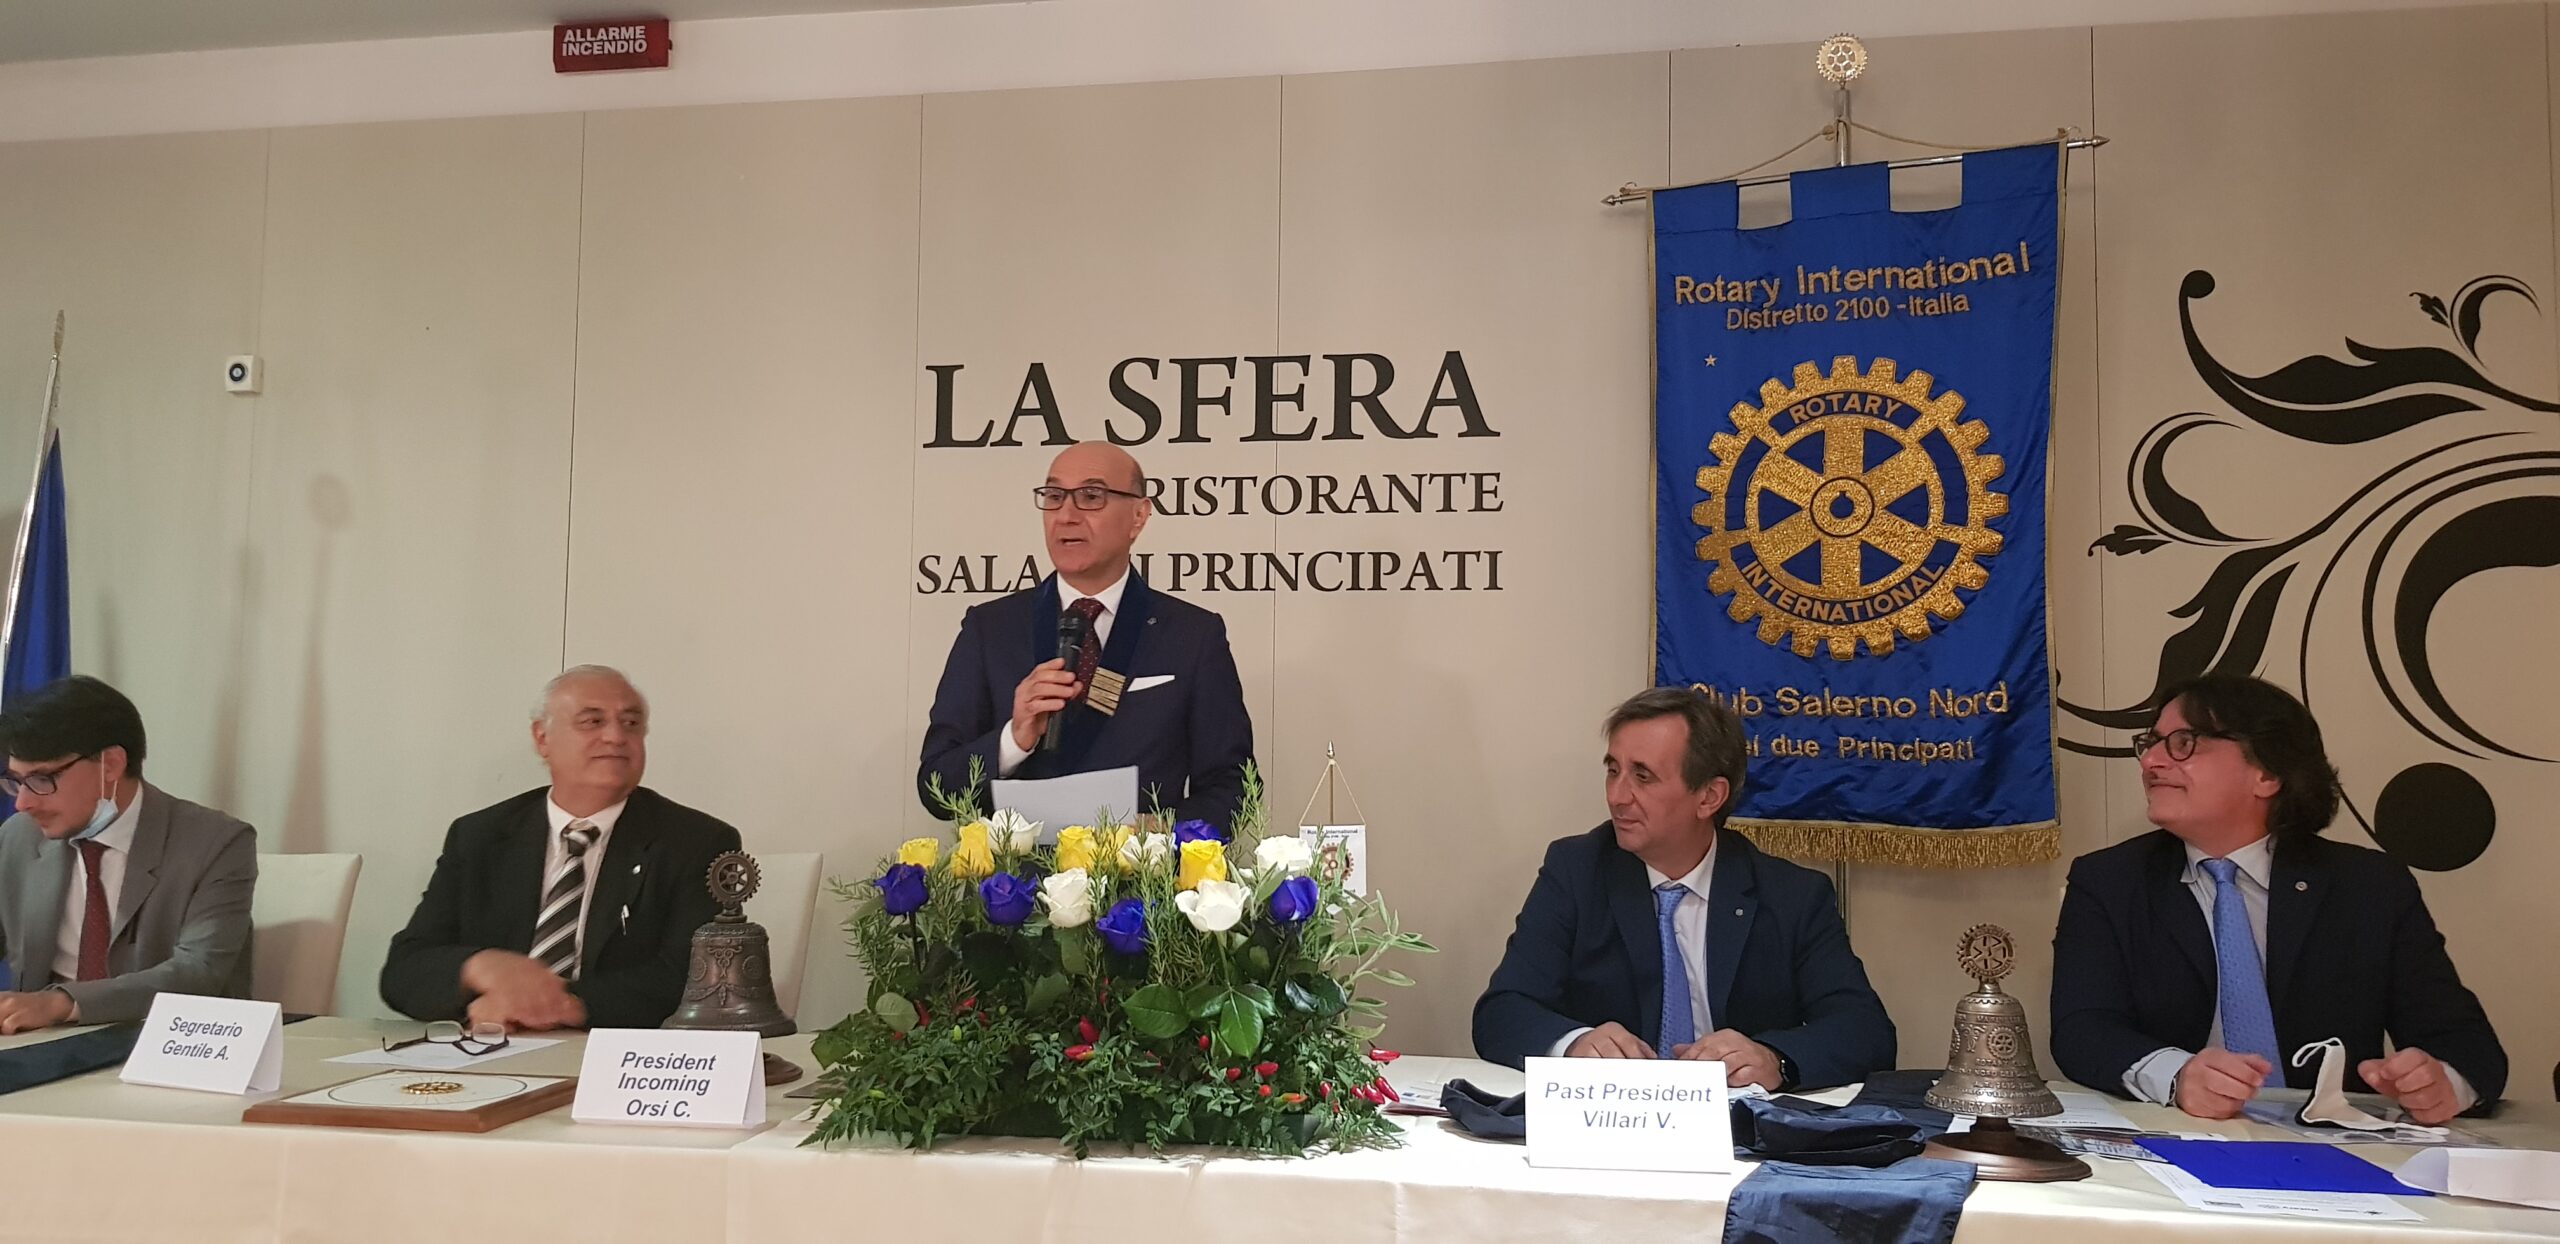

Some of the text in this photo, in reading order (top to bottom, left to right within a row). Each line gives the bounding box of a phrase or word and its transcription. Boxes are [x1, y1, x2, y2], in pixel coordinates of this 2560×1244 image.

[562, 39, 648, 56] INCENDIO
[563, 26, 646, 42] ALLARME
[1674, 240, 2031, 308] Rotary International
[1726, 301, 1829, 330] Distretto
[1834, 297, 1890, 321] 2100
[923, 350, 1501, 449] LA SFERA
[1789, 393, 1902, 424] ROTARY
[1145, 472, 1504, 517] RISTORANTE
[917, 554, 1042, 594] SALA
[1167, 550, 1504, 592] PRINCIPATI
[1740, 560, 1945, 623] INTERNATIONAL
[1775, 685, 1917, 719] Salerno
[1928, 680, 2009, 719] Nord
[1770, 734, 1821, 758] due
[1838, 735, 1975, 767] Principati
[169, 1016, 243, 1038] Segretario
[162, 1039, 230, 1061] Gentile A.
[620, 1051, 717, 1071] President
[617, 1072, 711, 1096] Incoming
[1544, 1081, 1712, 1102] Past President
[626, 1099, 692, 1118] Orsi C.
[1583, 1110, 1676, 1130] Villari V.
